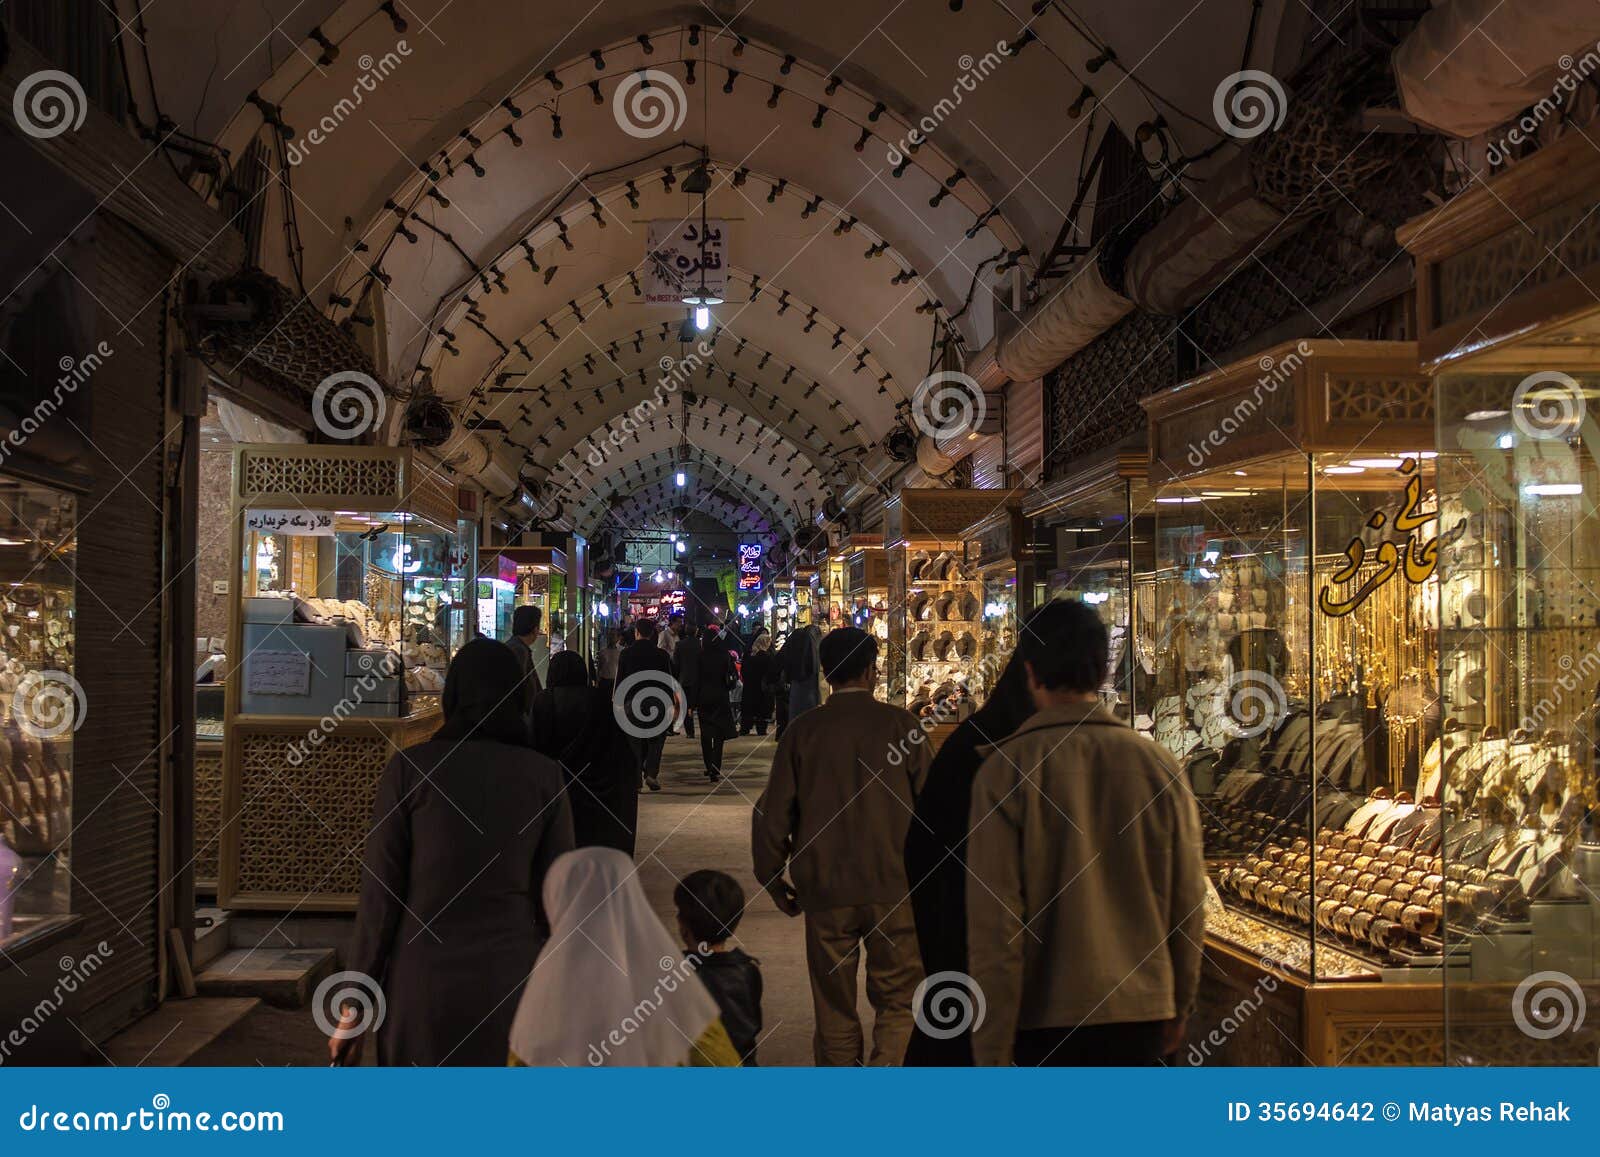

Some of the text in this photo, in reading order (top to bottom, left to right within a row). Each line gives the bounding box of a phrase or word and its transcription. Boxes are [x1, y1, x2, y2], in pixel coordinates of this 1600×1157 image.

[682, 224, 721, 248] یزد
[676, 251, 721, 276] نقره
[248, 514, 332, 531] طلا و سکه خریداریم
